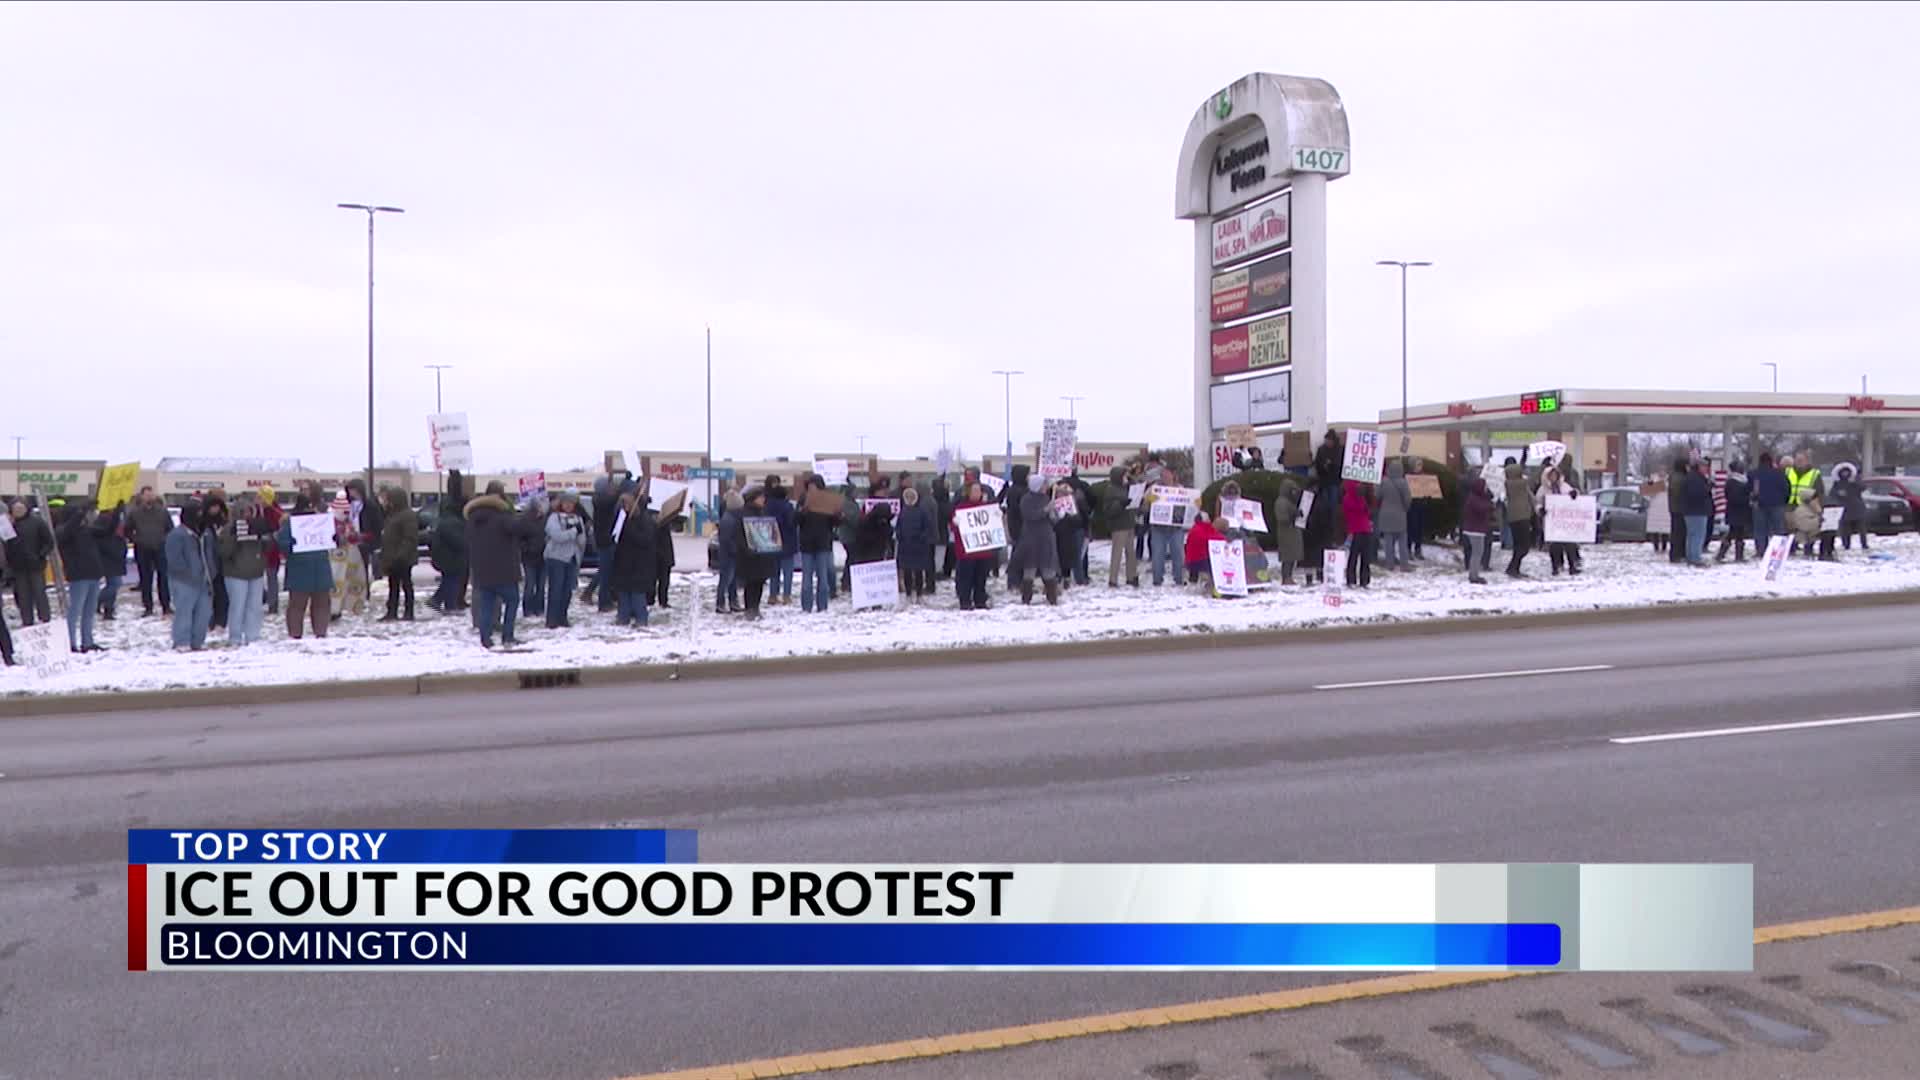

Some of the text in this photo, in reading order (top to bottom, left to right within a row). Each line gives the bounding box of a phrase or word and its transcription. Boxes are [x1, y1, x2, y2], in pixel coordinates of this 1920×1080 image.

[1295, 149, 1345, 170] 1407
[1217, 217, 1242, 241] LAURA
[1232, 236, 1247, 256] SPA
[1250, 316, 1287, 334] LAKEWOOD
[1256, 331, 1280, 343] FAMILY
[1250, 341, 1287, 365] DENTAL
[1358, 432, 1379, 446] ICE
[1351, 442, 1377, 457] OUT
[1351, 455, 1377, 469] FOR
[19, 472, 79, 483] DOLLAR
[966, 510, 990, 528] END
[964, 528, 1004, 549] VIOLENCE
